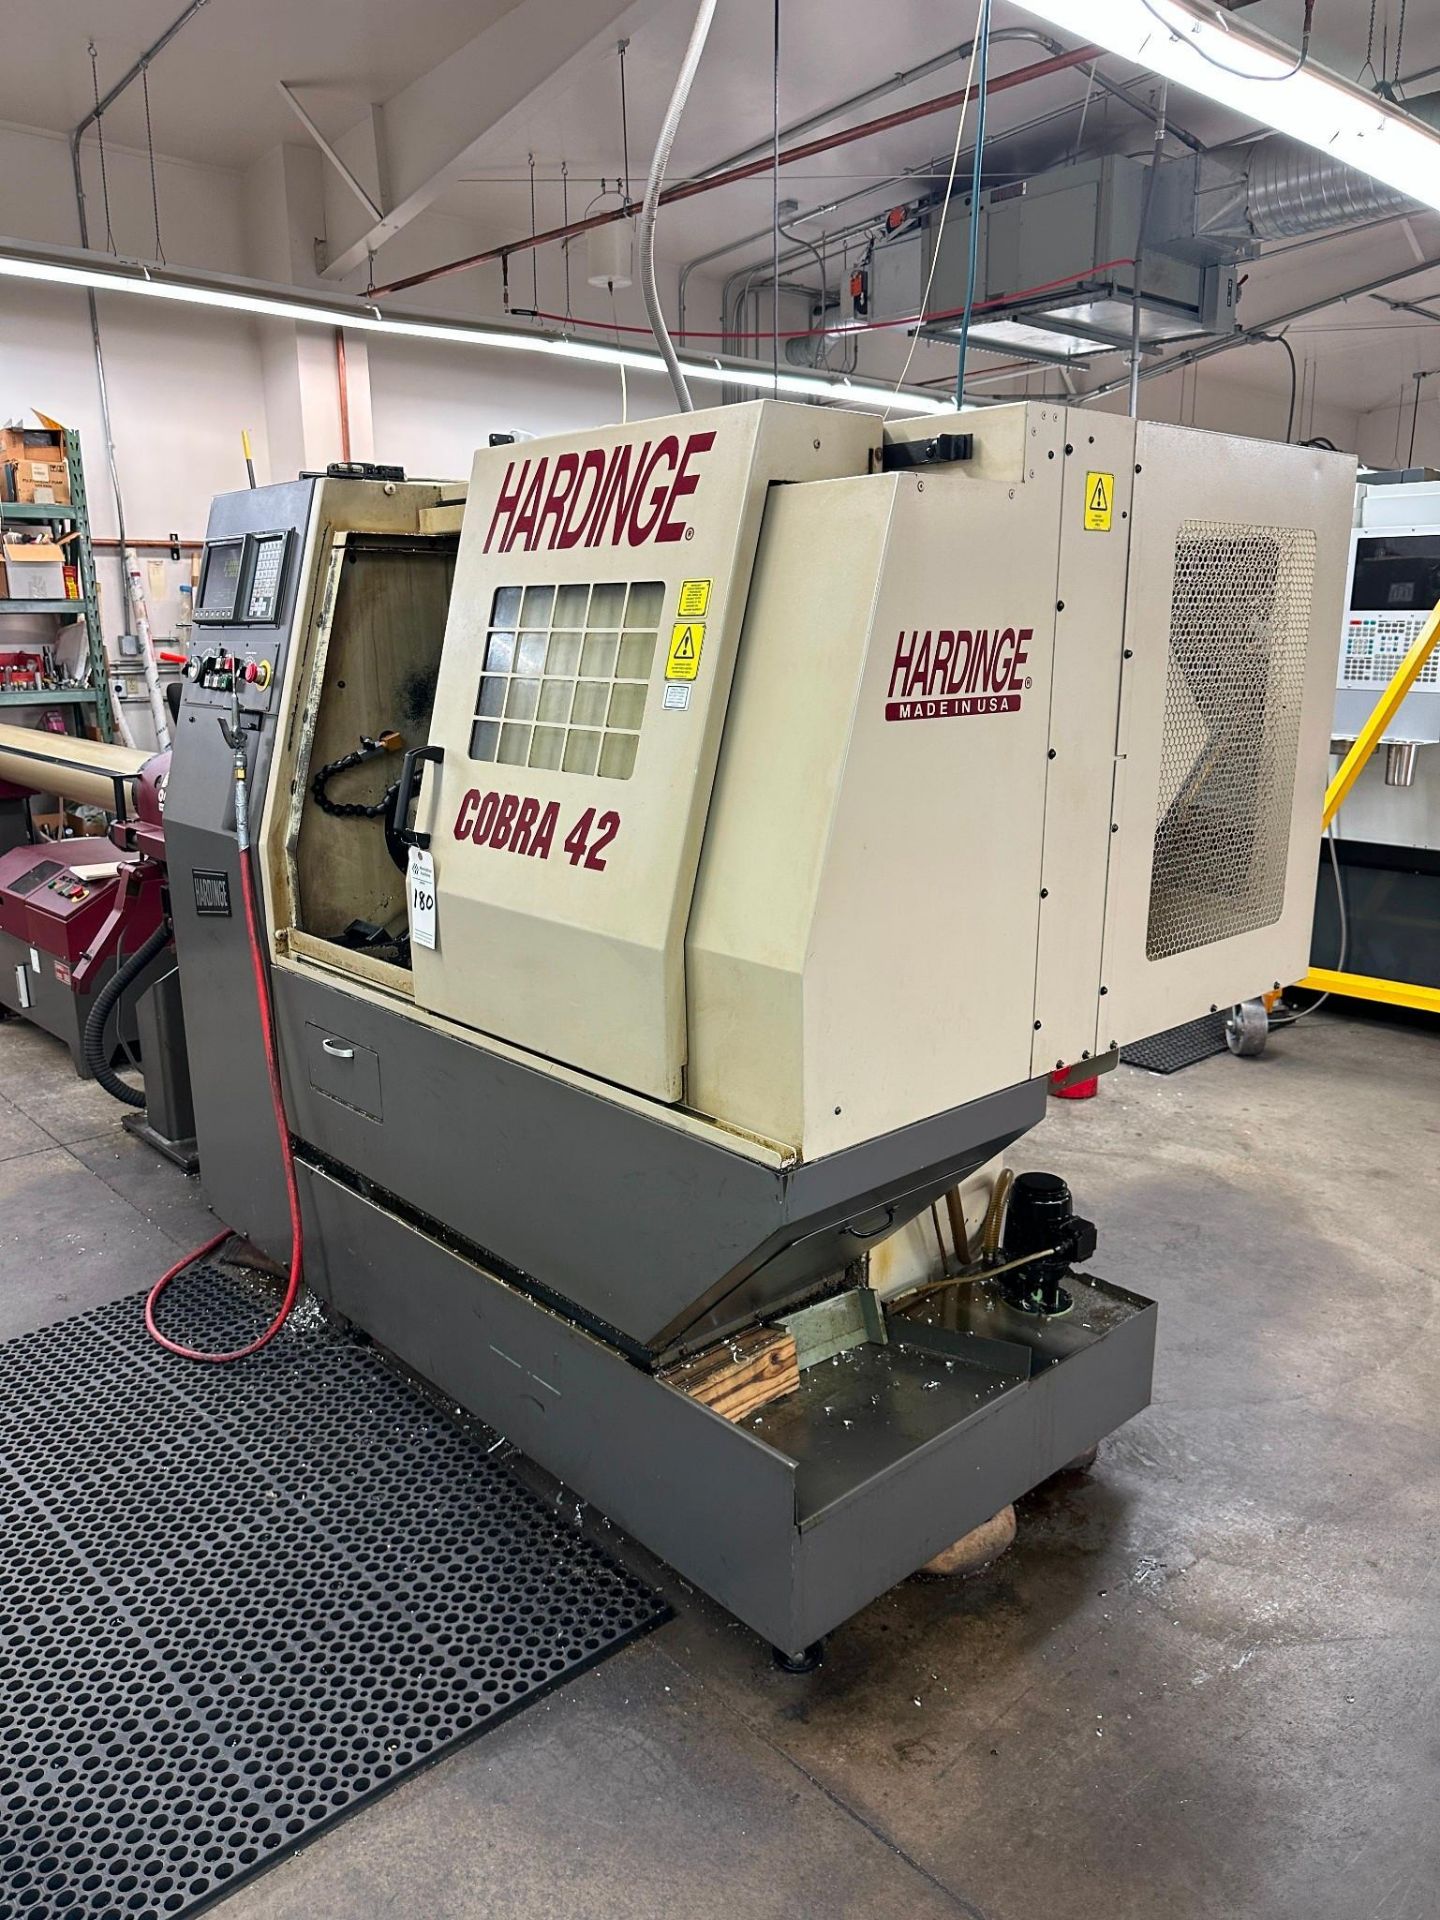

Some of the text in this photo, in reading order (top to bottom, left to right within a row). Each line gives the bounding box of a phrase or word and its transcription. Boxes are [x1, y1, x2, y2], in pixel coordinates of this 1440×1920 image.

[483, 431, 716, 554] HARDINGE
[887, 628, 1034, 698] HARDINGE
[899, 698, 1009, 719] MADE IN USA
[453, 789, 621, 872] COBRA 42
[194, 877, 228, 907] HARDINGE
[414, 887, 434, 911] 180
